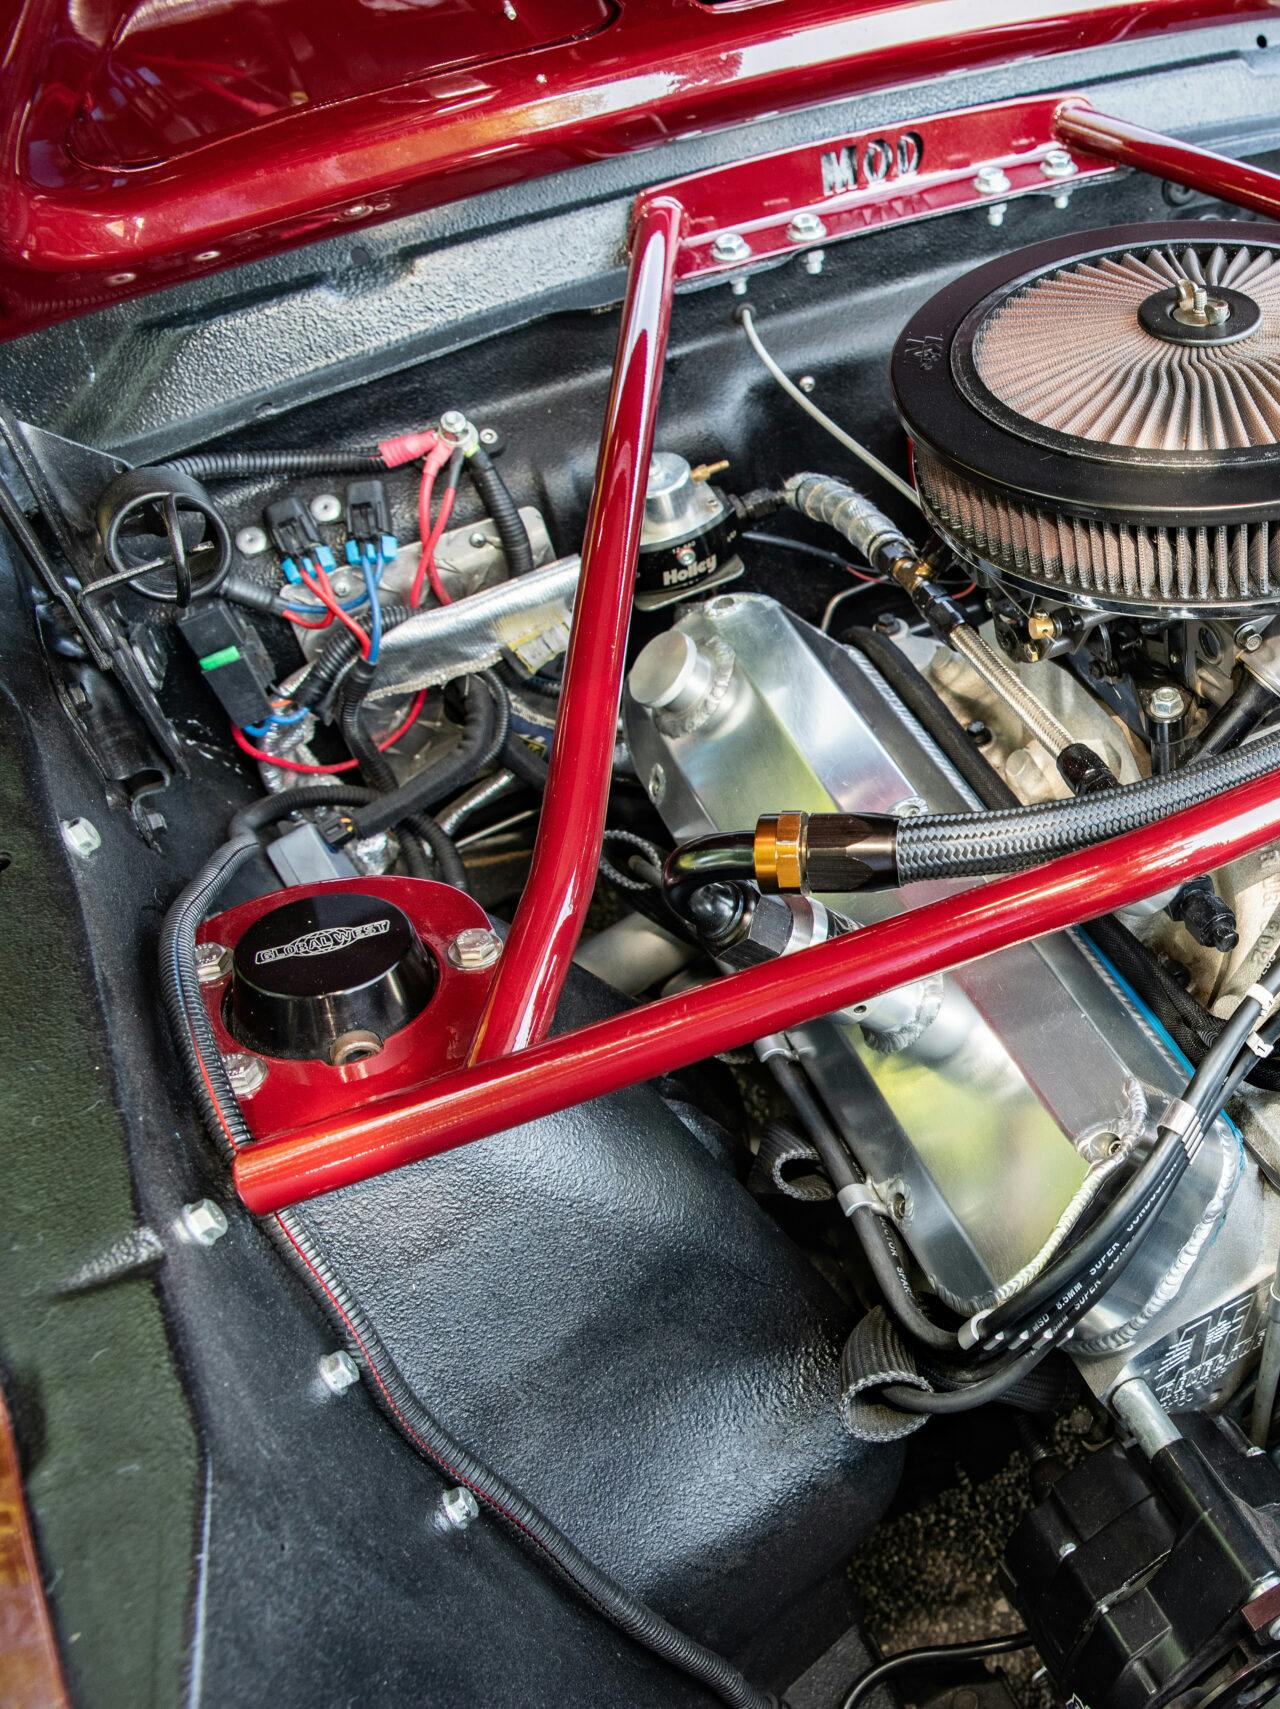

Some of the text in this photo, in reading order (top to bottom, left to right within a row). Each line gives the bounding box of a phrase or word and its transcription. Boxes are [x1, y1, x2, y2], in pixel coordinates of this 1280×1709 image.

[821, 131, 924, 197] MOD
[662, 554, 718, 587] Holley
[260, 922, 390, 962] GLOBAL WEST
[1031, 1313, 1050, 1333] MSD
